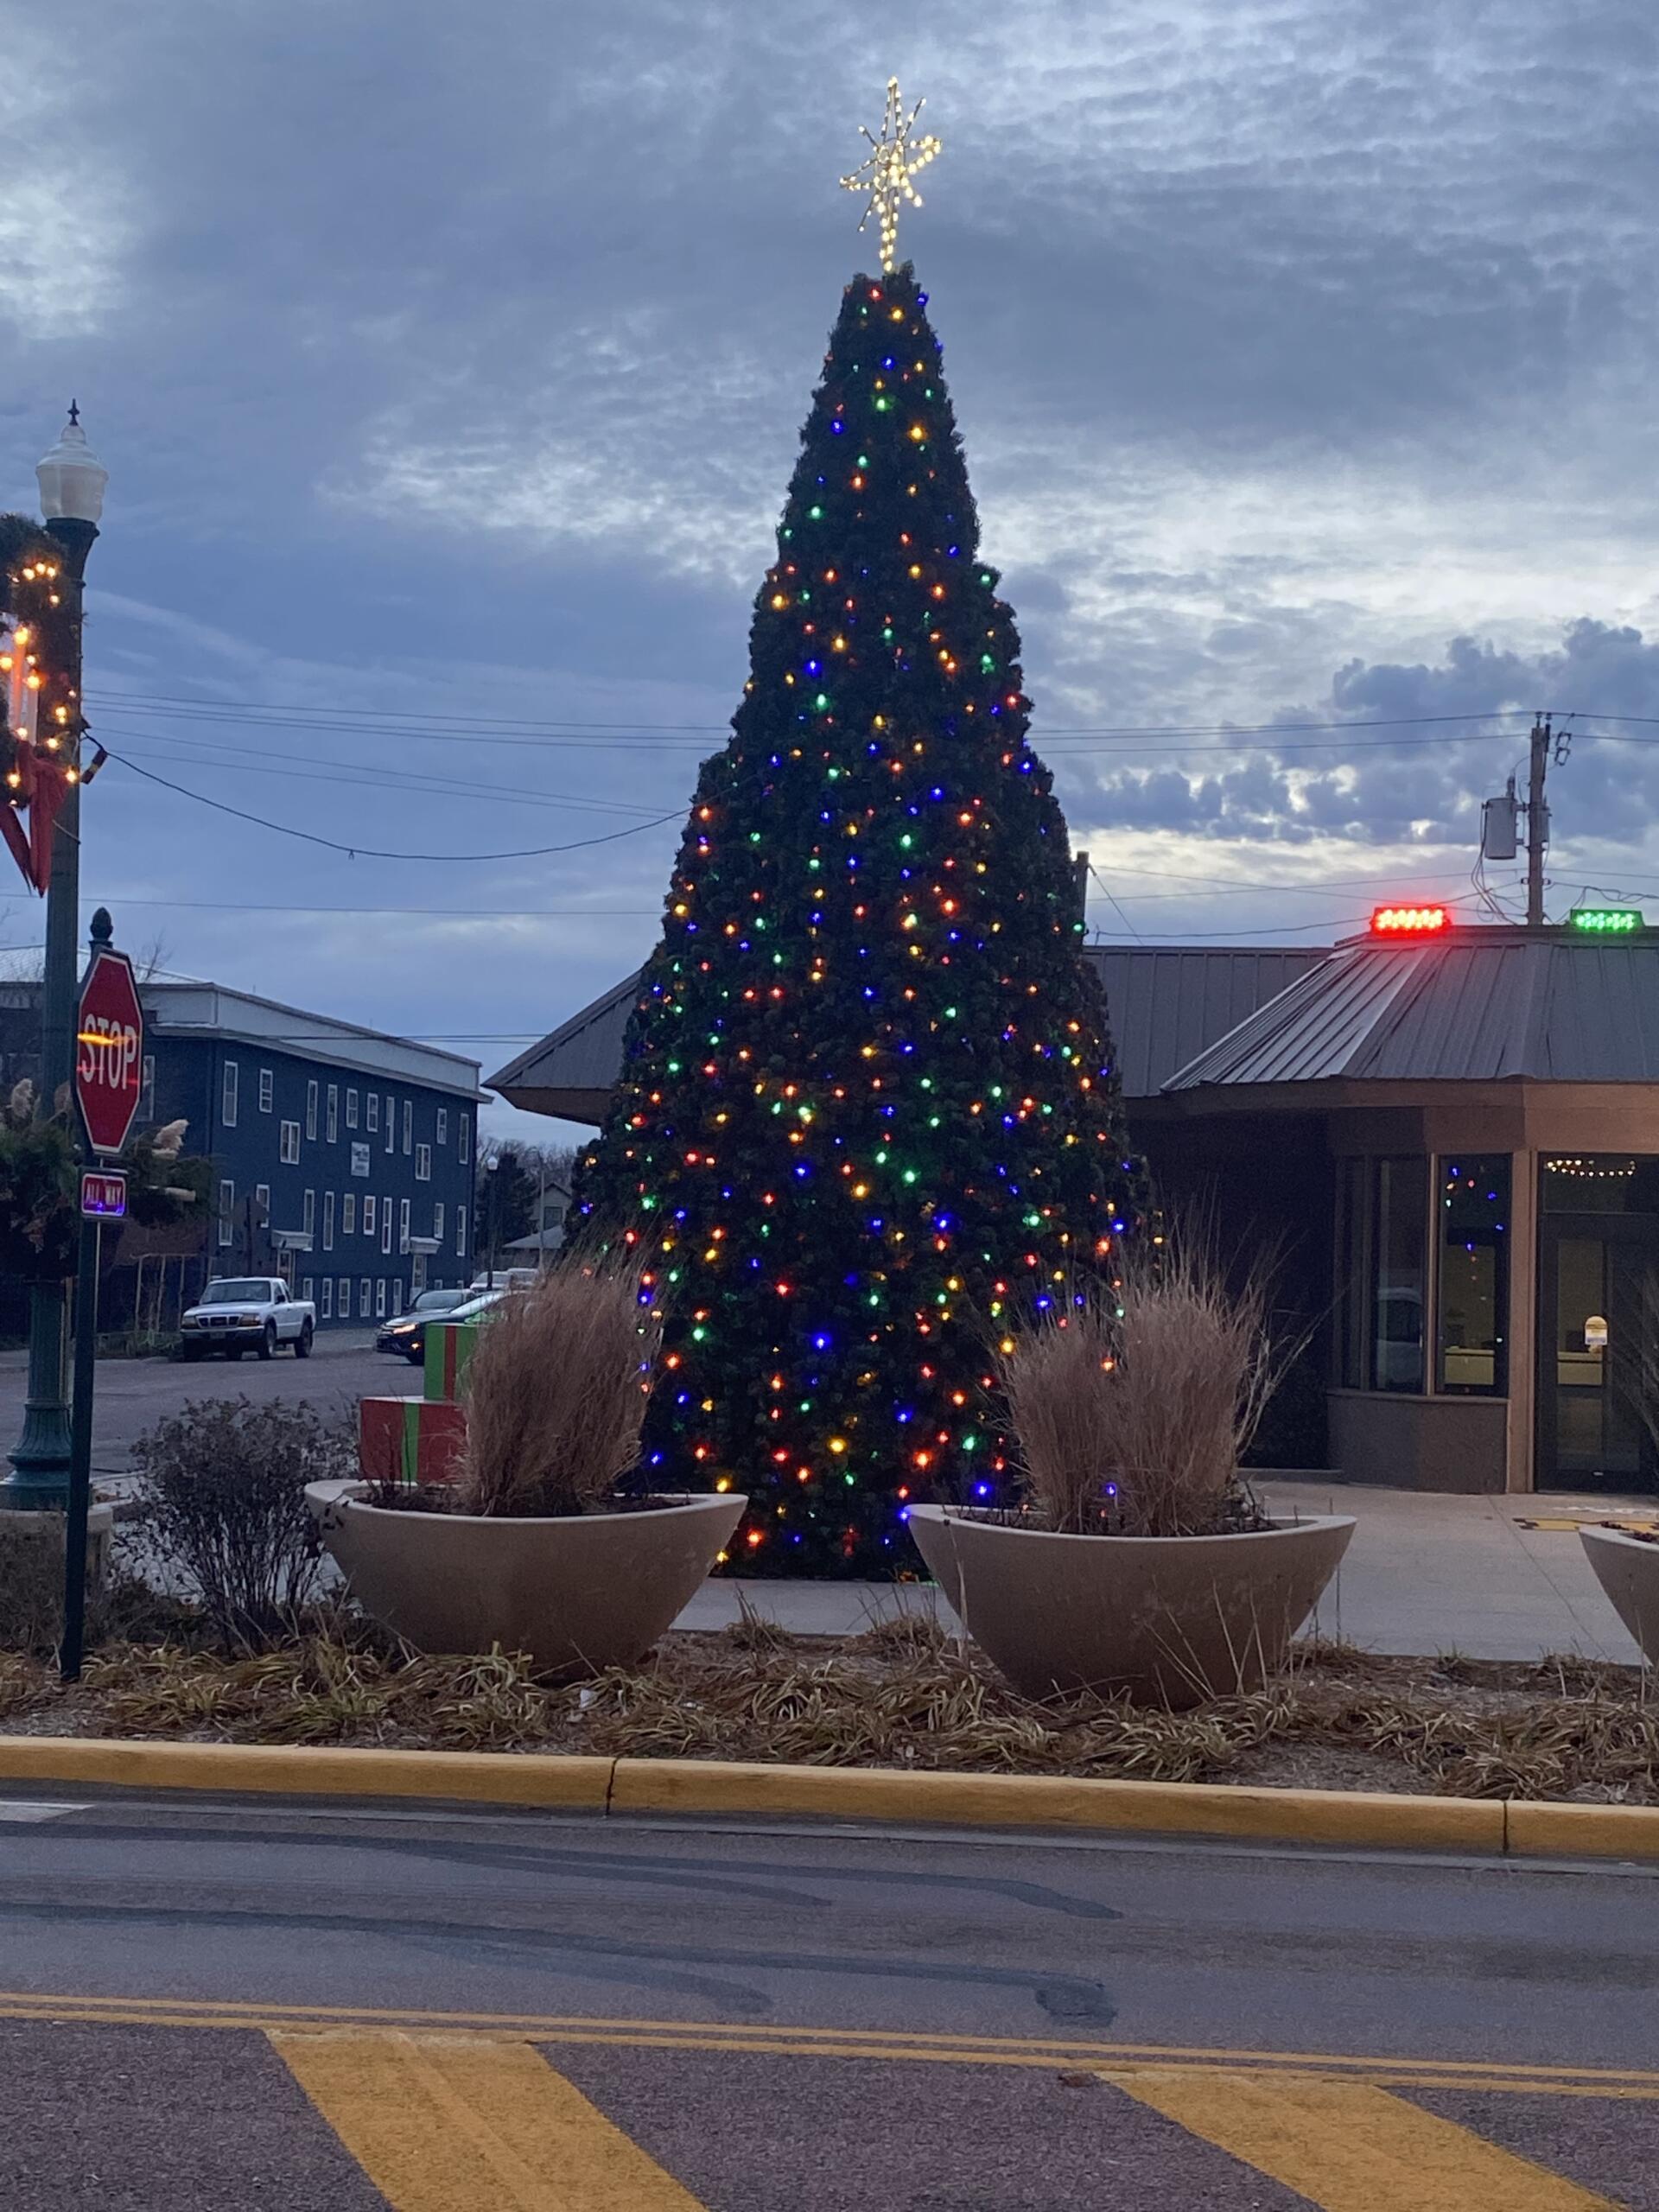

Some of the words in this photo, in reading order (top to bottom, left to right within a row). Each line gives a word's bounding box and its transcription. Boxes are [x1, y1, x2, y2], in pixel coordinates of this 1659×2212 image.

[82, 1014, 137, 1090] STOP
[86, 1183, 100, 1205] ALL
[105, 1185, 122, 1205] WAY
